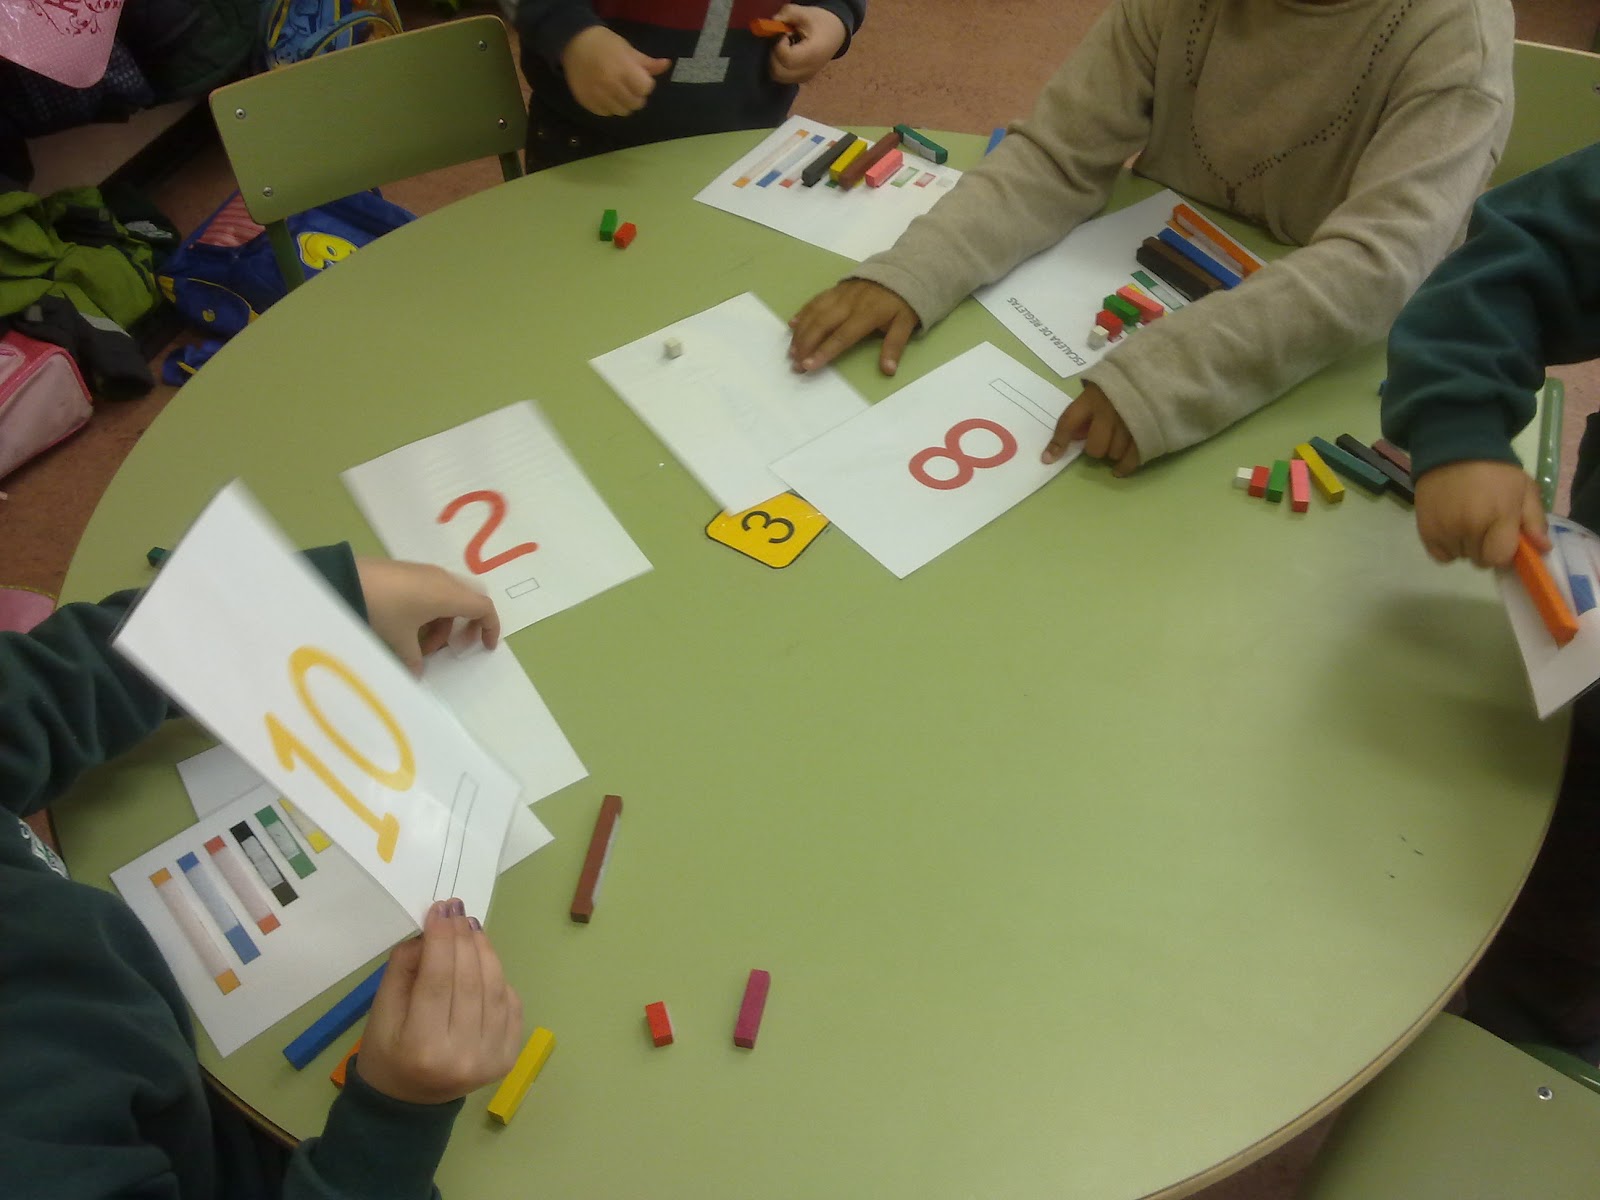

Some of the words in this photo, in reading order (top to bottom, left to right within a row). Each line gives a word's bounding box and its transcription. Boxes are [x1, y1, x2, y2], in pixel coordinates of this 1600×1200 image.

[1006, 297, 1043, 327] REGLETAS
[1038, 326, 1053, 336] DE
[1049, 335, 1087, 366] ESCALERA
[909, 419, 1018, 491] 8
[437, 489, 539, 574] 2
[741, 510, 795, 545] 3
[265, 646, 417, 863] 10
